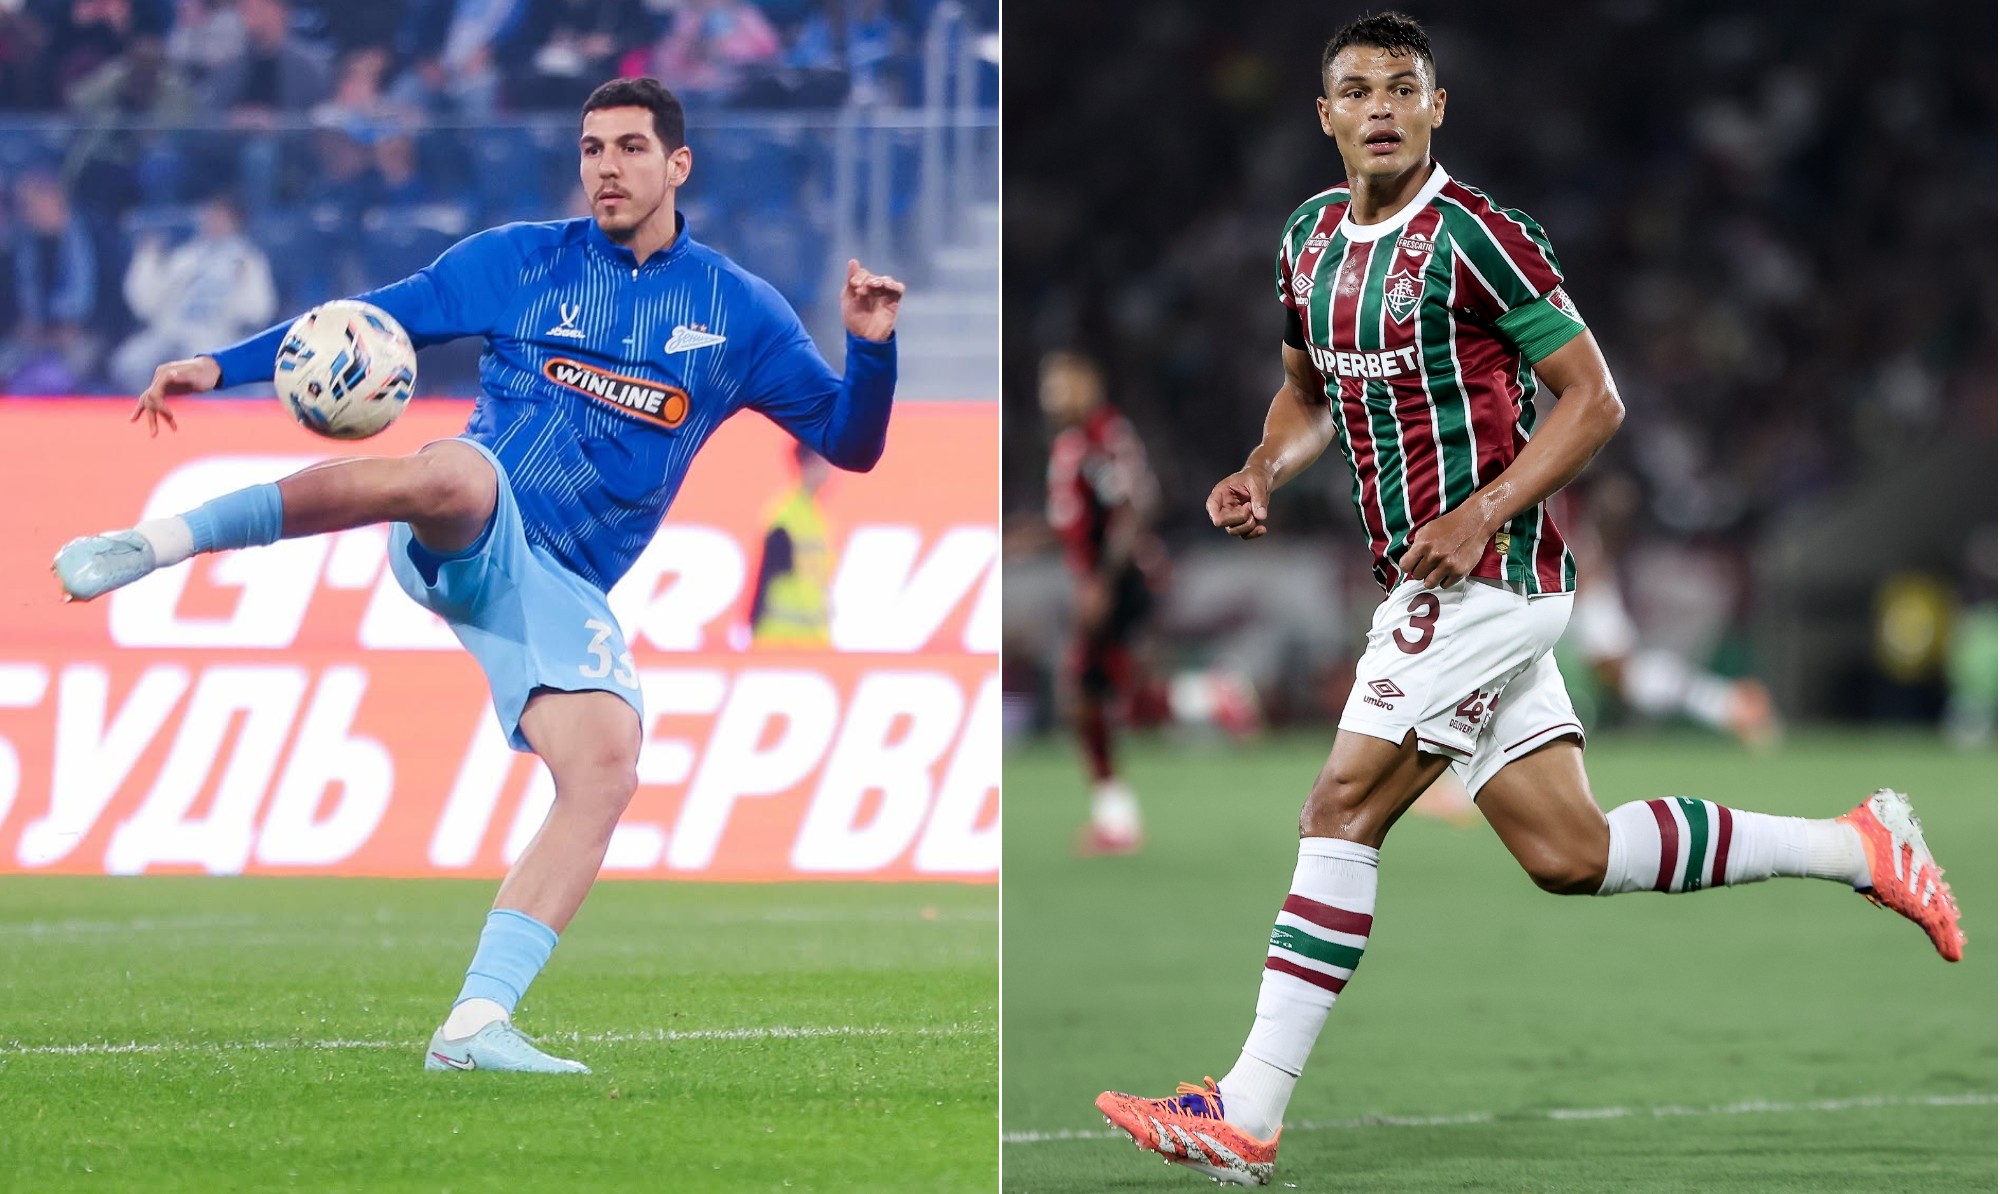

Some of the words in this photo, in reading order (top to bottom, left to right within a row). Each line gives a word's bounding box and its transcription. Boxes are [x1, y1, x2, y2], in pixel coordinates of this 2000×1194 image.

[1398, 239, 1434, 252] FRESCATTO
[556, 364, 666, 414] WINLINE
[1392, 592, 1441, 655] 3
[1363, 695, 1394, 711] umbro
[1449, 718, 1475, 735] DELIVERY
